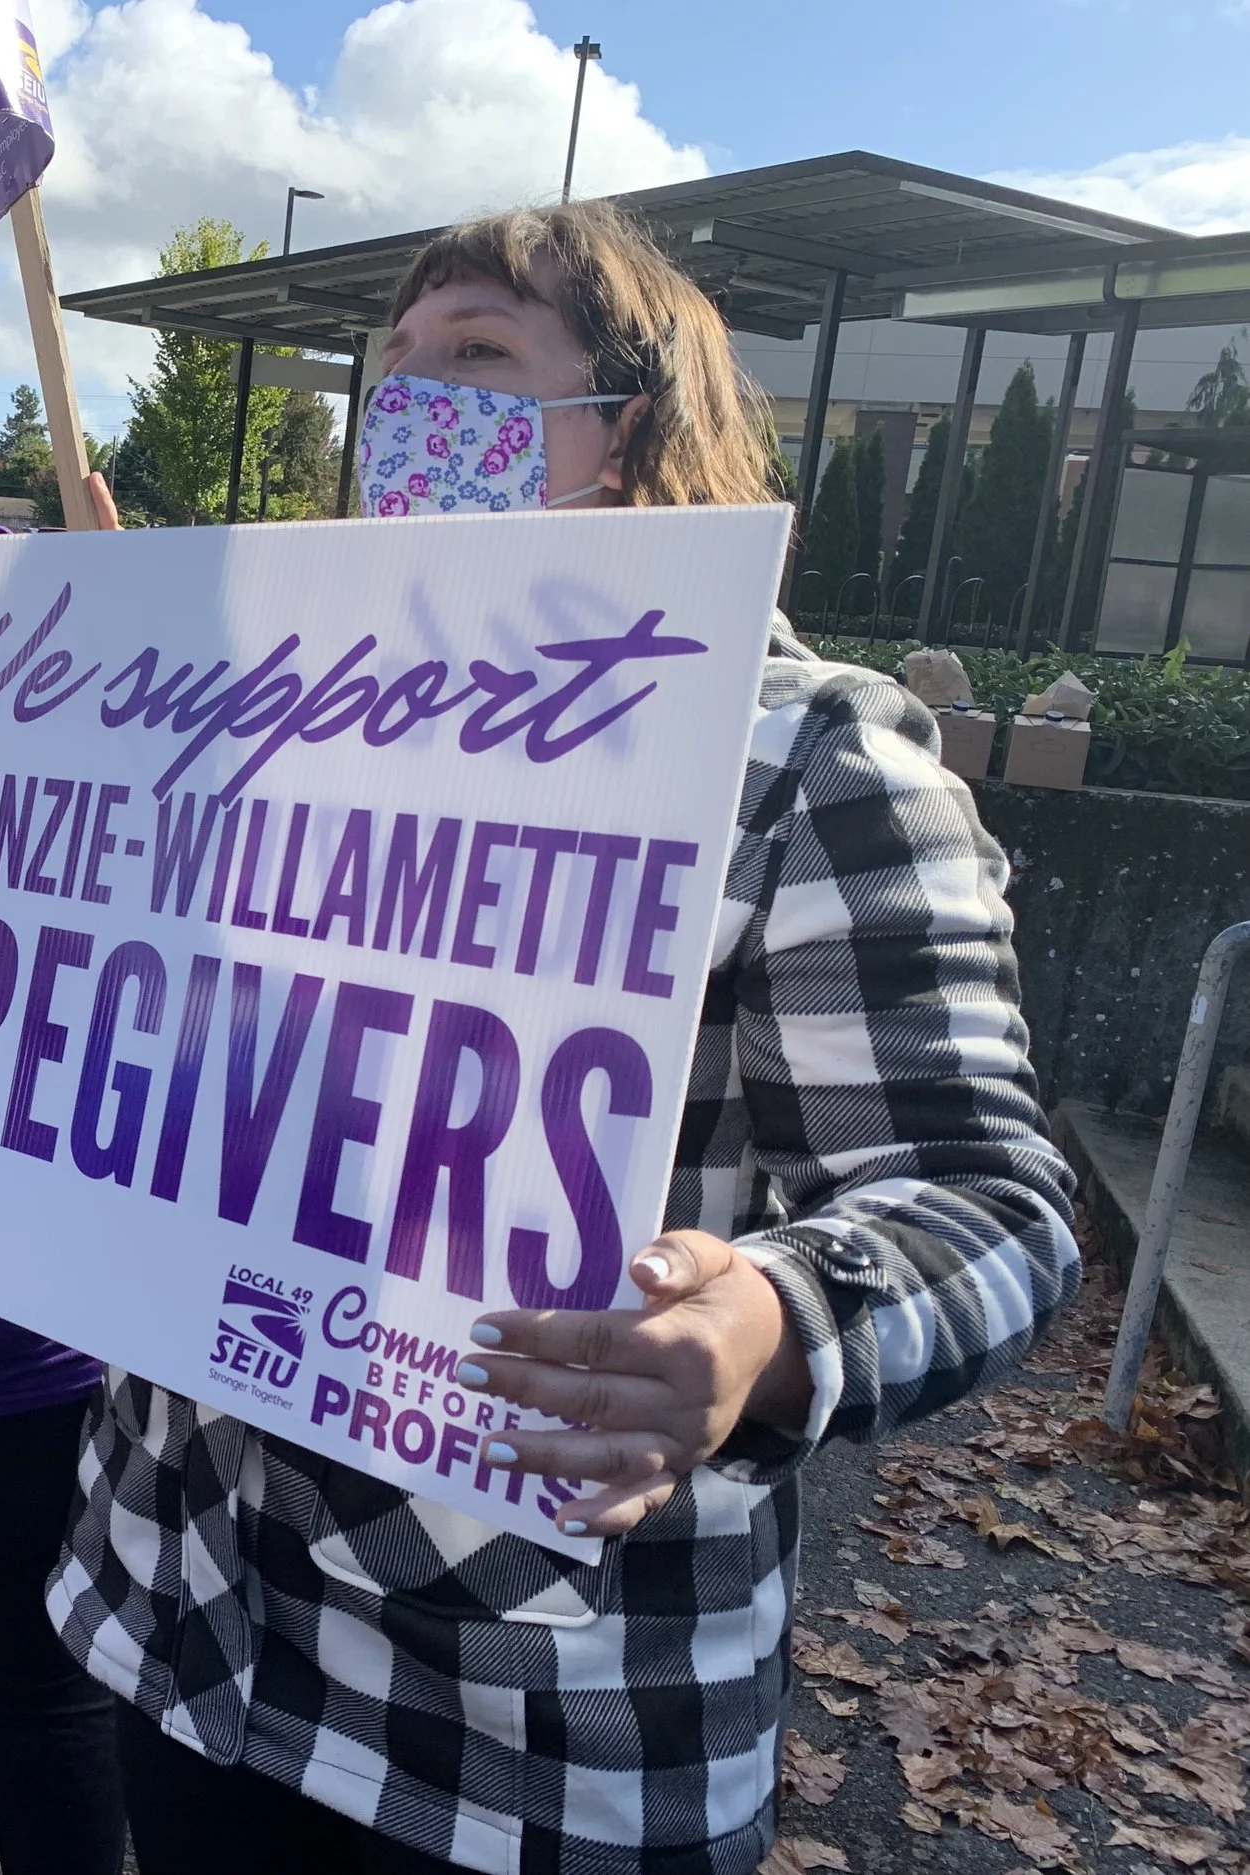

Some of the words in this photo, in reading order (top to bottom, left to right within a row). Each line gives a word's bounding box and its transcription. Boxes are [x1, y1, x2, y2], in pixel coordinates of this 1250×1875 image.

[19, 69, 45, 104] EIU
[100, 607, 710, 804] support
[227, 1264, 285, 1297] LOCAL
[290, 1286, 314, 1304] 49
[209, 1334, 300, 1389] SEIU
[207, 1367, 251, 1395] Stronger
[251, 1386, 294, 1411] Together
[366, 1361, 521, 1431] BEFORE
